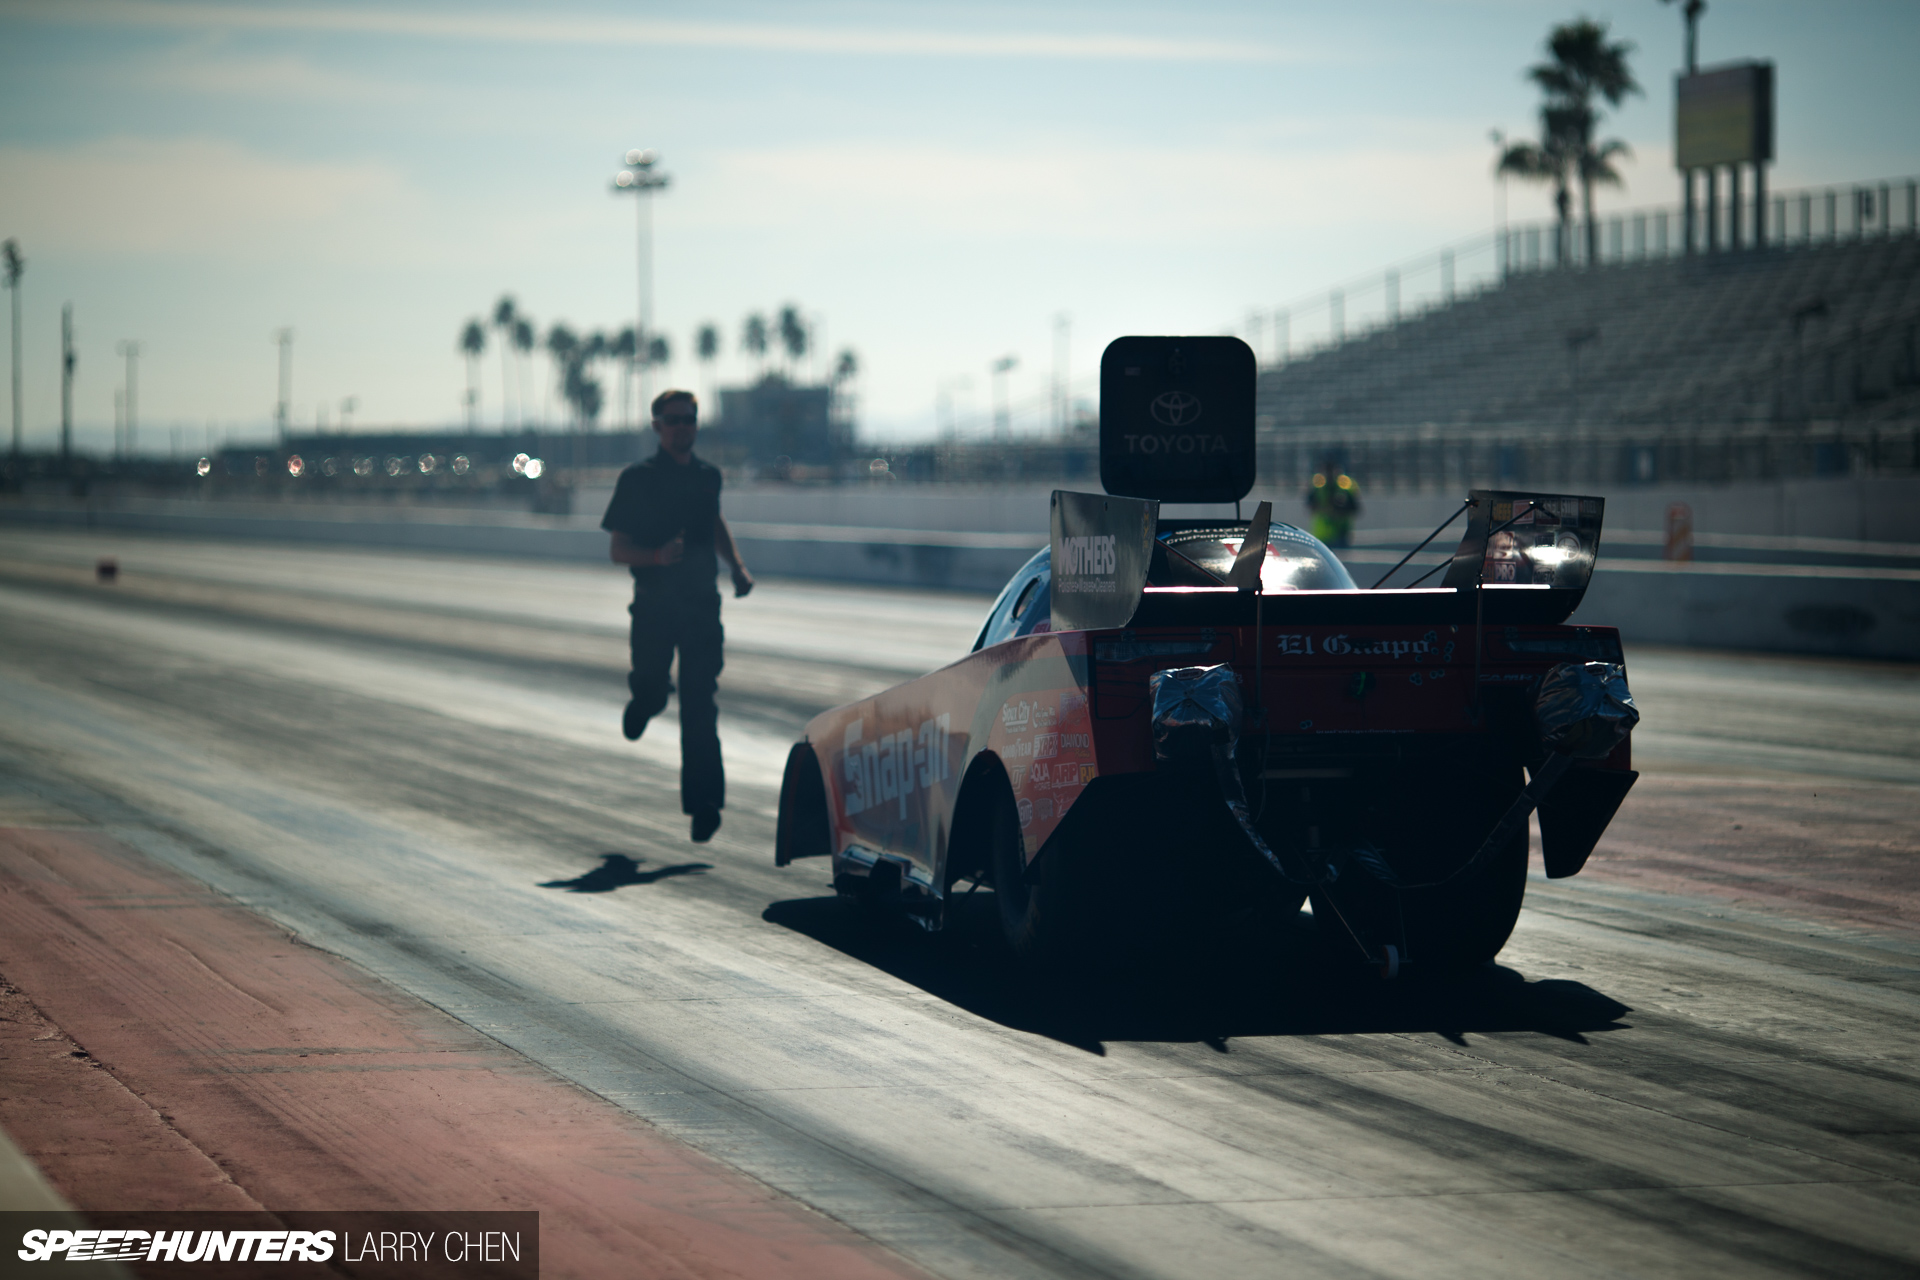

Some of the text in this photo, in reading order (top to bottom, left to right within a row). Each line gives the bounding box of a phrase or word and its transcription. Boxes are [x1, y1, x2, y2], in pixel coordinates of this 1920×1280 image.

[1124, 434, 1228, 454] TOYOTA
[1058, 534, 1116, 576] MOTHERS
[1277, 632, 1316, 656] El
[1060, 733, 1090, 748] DIAMOND
[844, 712, 951, 821] Snap-on
[1028, 763, 1050, 783] AQUA
[1054, 764, 1078, 784] ARP
